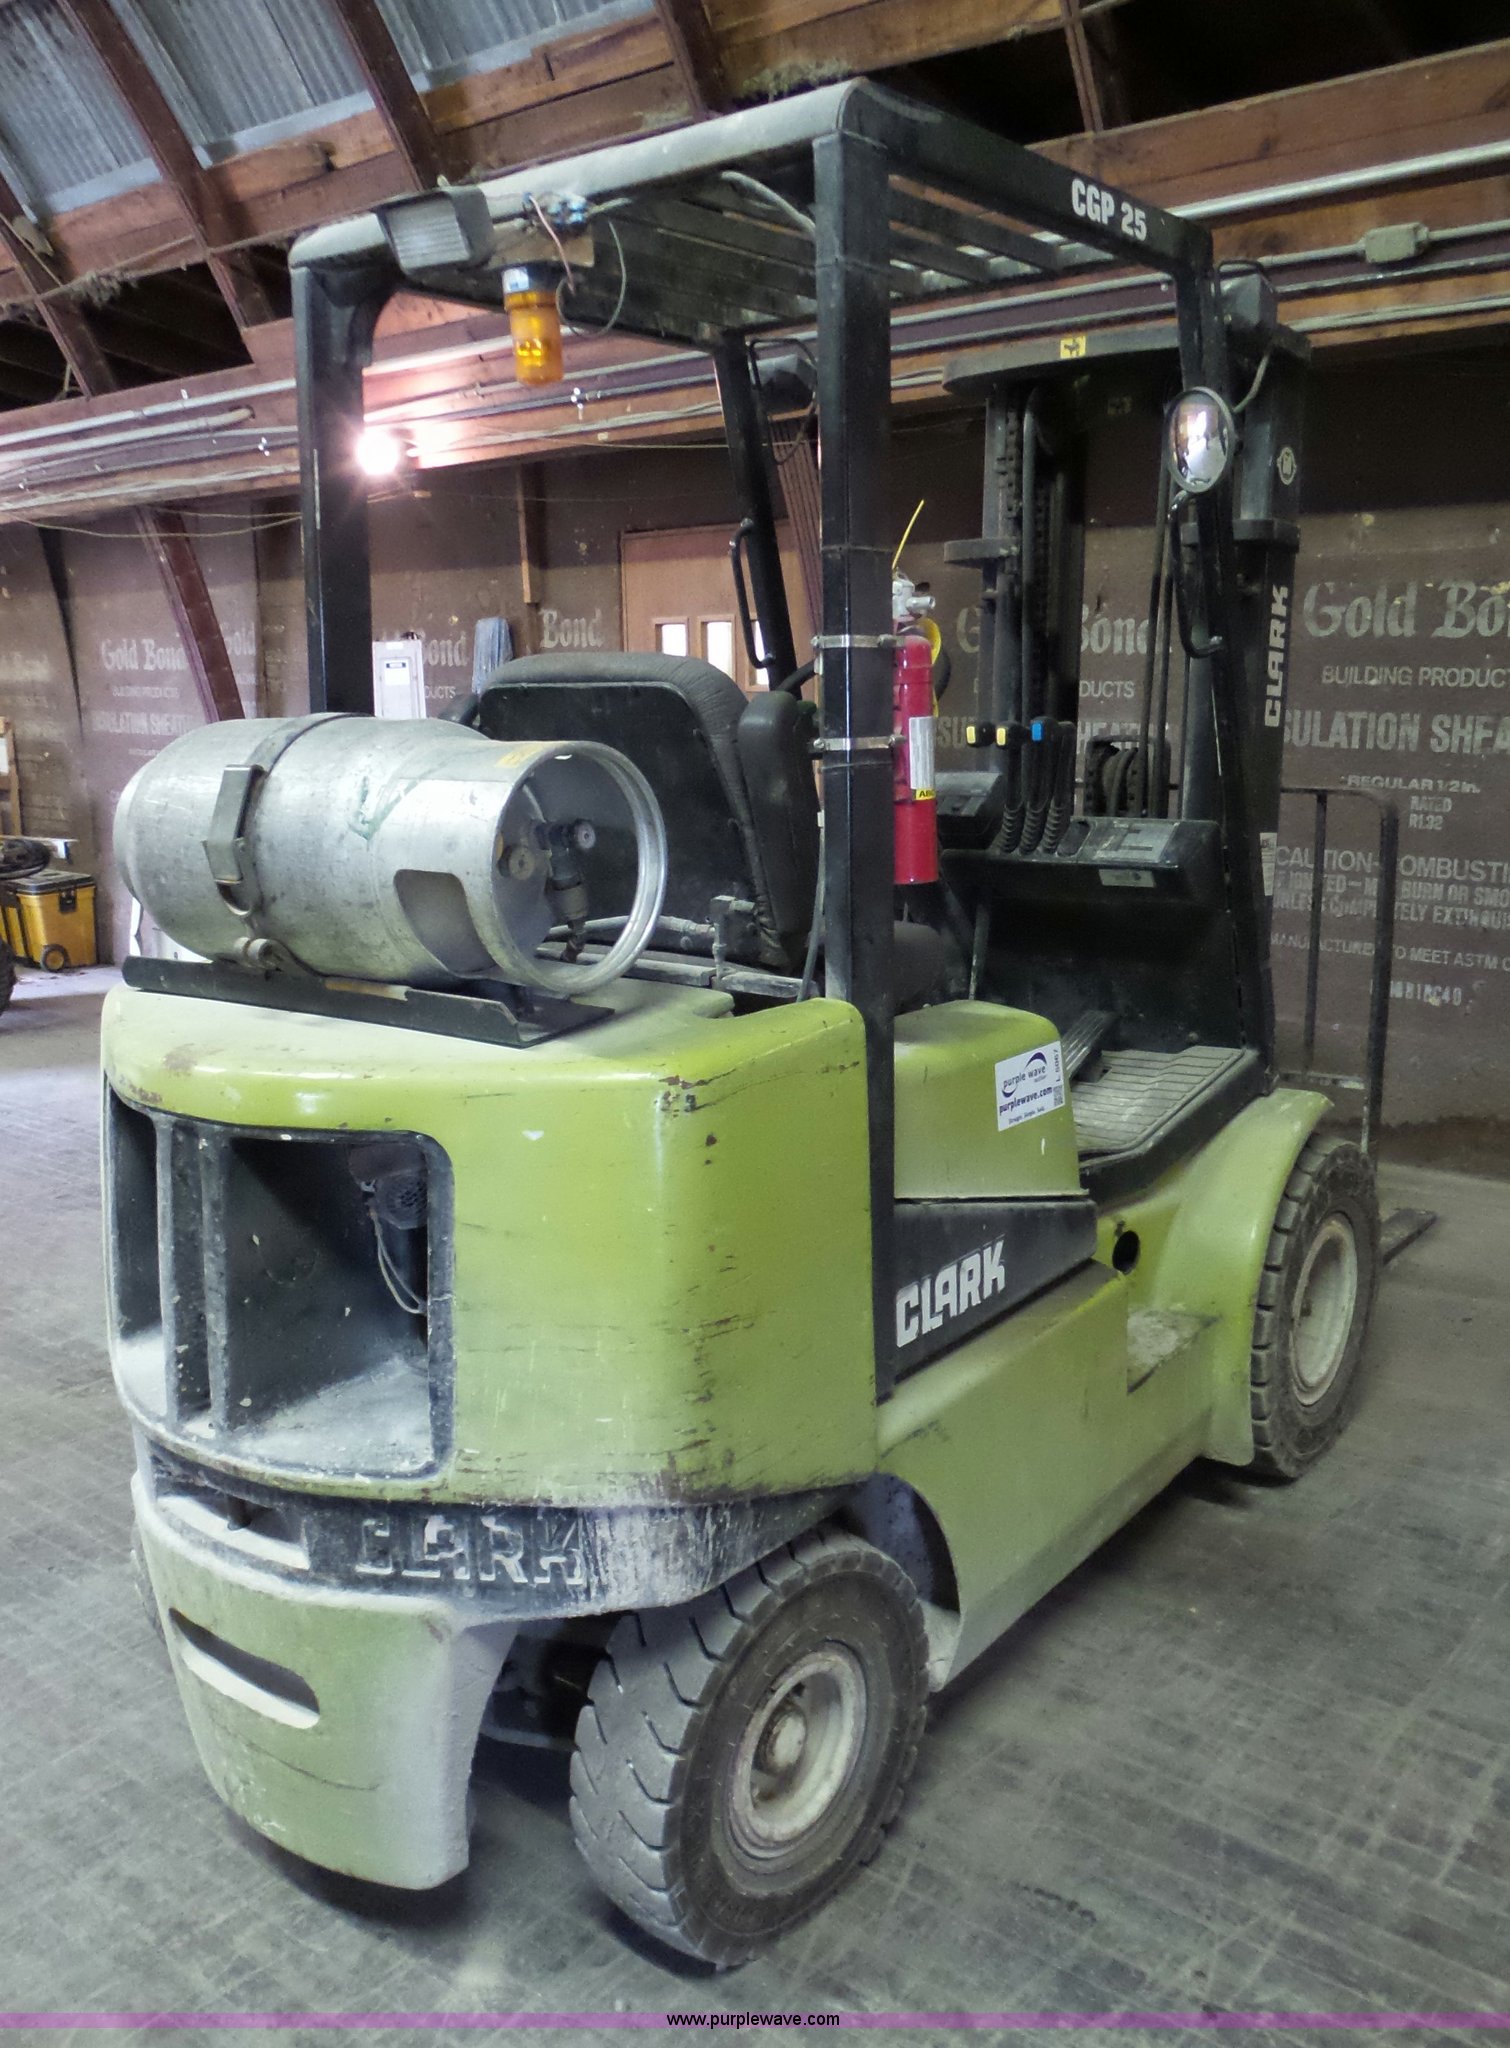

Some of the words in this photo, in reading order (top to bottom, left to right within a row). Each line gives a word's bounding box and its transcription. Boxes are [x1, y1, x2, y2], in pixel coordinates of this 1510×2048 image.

[1072, 178, 1115, 225] CGP
[1121, 201, 1147, 241] 25
[1303, 580, 1418, 638] Gold
[1431, 580, 1510, 638] Bo
[540, 609, 604, 648] Bond
[102, 639, 139, 670] Gold
[1264, 584, 1288, 728] CLARK
[1321, 665, 1412, 687] BUILDING
[1347, 774, 1433, 791] REGULAR
[1400, 855, 1510, 884] OMBUSTI
[1401, 880, 1444, 901] BURN
[1409, 948, 1451, 965] MEET
[1453, 952, 1498, 970] ASTM
[1003, 1073, 1027, 1090] purple
[1027, 1065, 1047, 1078] wave
[999, 1086, 1053, 1117] purplewave.com
[896, 1240, 1006, 1348] CLARK
[355, 1513, 586, 1586] CLARK
